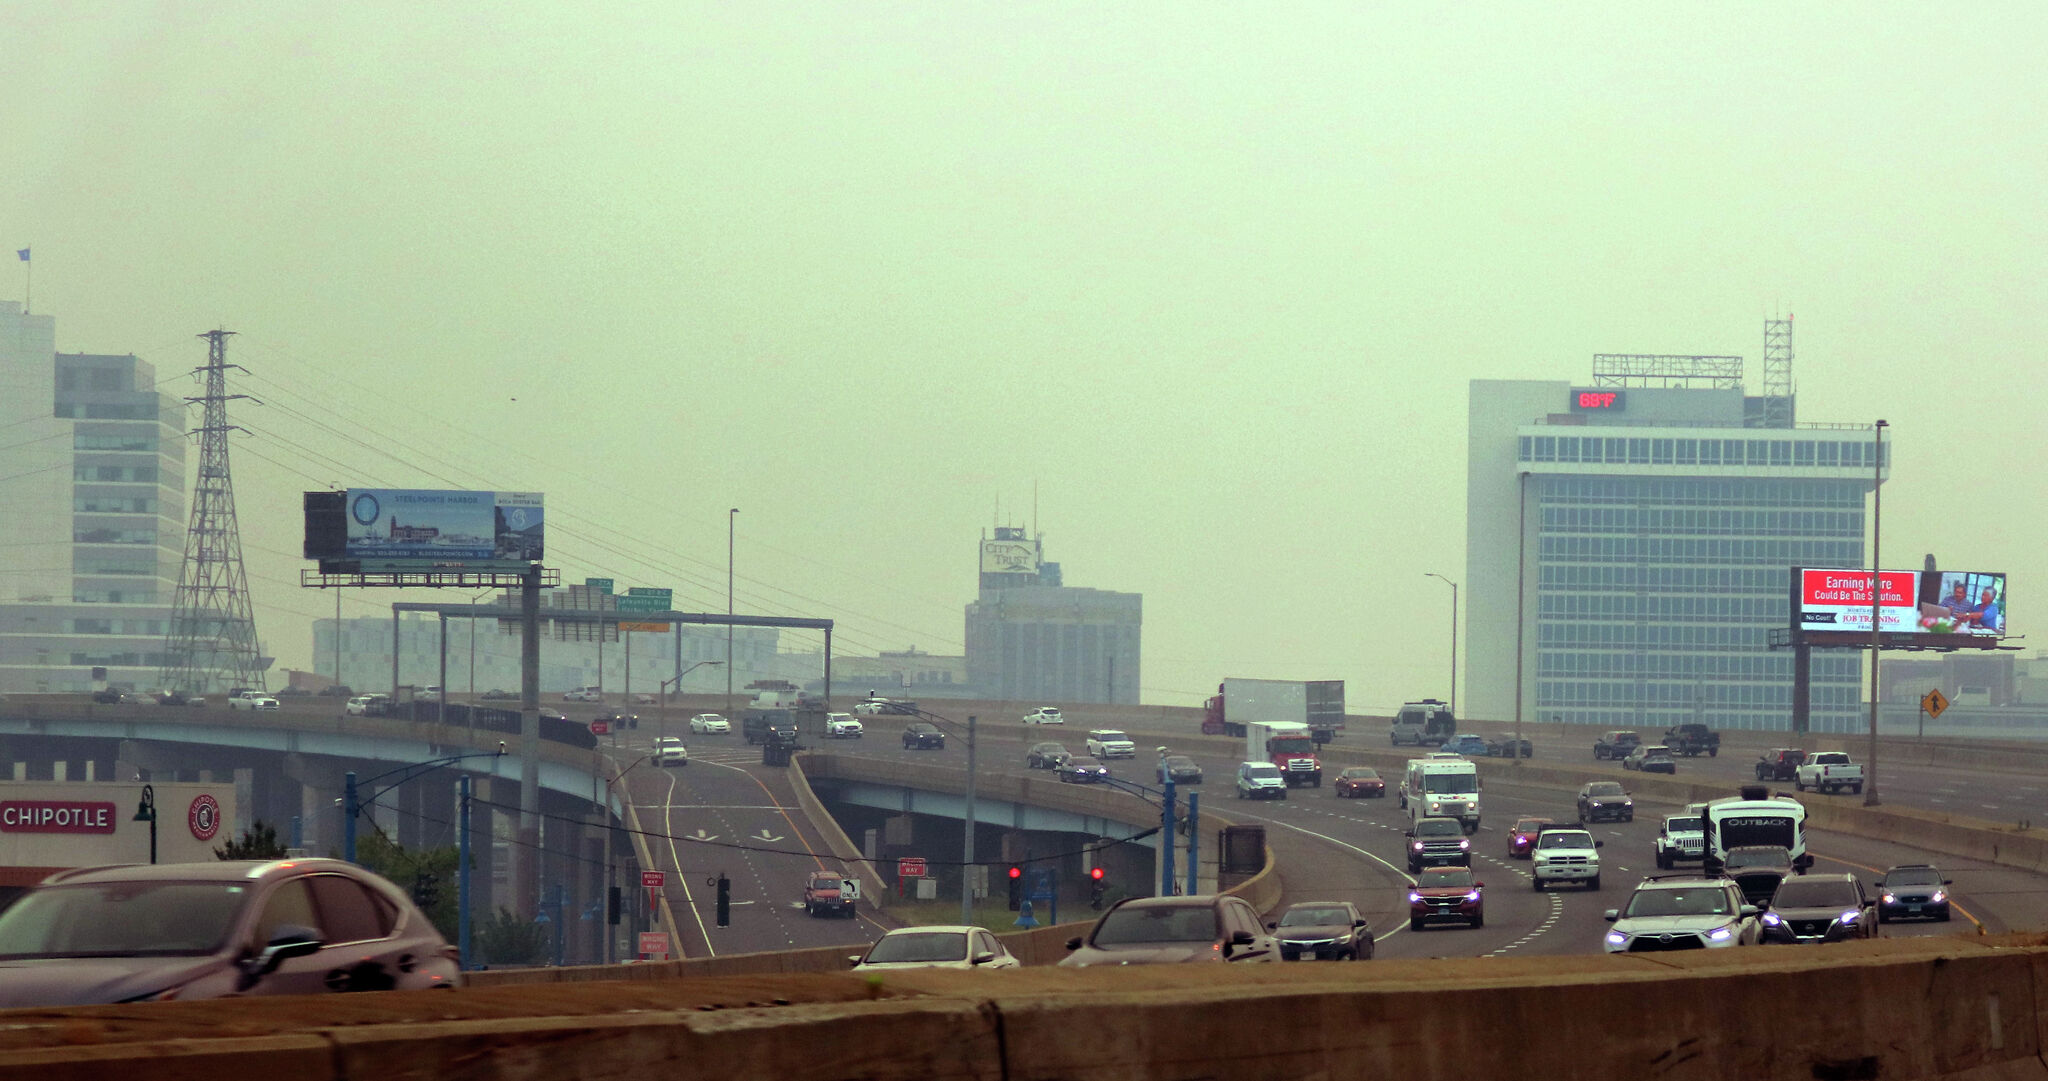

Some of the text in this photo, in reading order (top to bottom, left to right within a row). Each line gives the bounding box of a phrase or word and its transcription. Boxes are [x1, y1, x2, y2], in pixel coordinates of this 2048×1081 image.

[447, 496, 479, 504] HARBOR
[1826, 576, 1892, 591] Earning Mre
[1814, 590, 1904, 602] Could Be The Sution.
[1842, 615, 1900, 624] JOB TRANING
[3, 807, 108, 827] CHIPOTLE
[1728, 818, 1787, 826] OUTBACK
